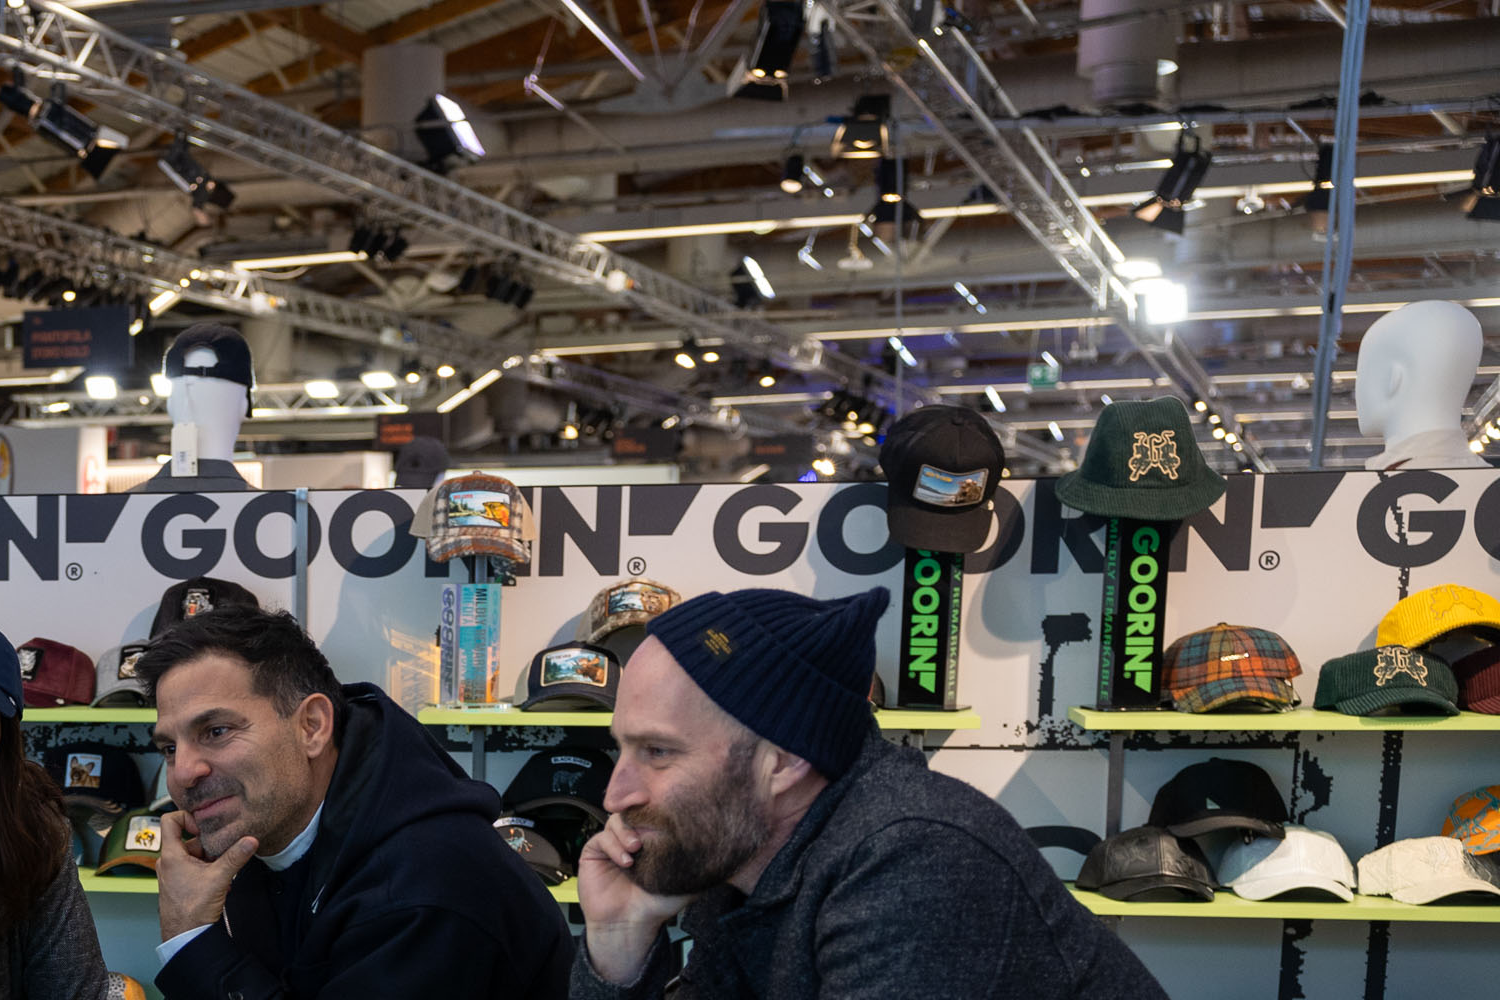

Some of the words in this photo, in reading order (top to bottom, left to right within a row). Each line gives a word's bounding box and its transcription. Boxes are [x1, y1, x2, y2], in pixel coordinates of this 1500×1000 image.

[1107, 518, 1118, 580] MILDLY
[1357, 470, 1500, 568] G
[476, 588, 487, 625] MILDLY
[947, 587, 961, 700] REMARKABLE
[1100, 585, 1115, 700] REMARKABLE
[1124, 527, 1160, 671] GOORIN
